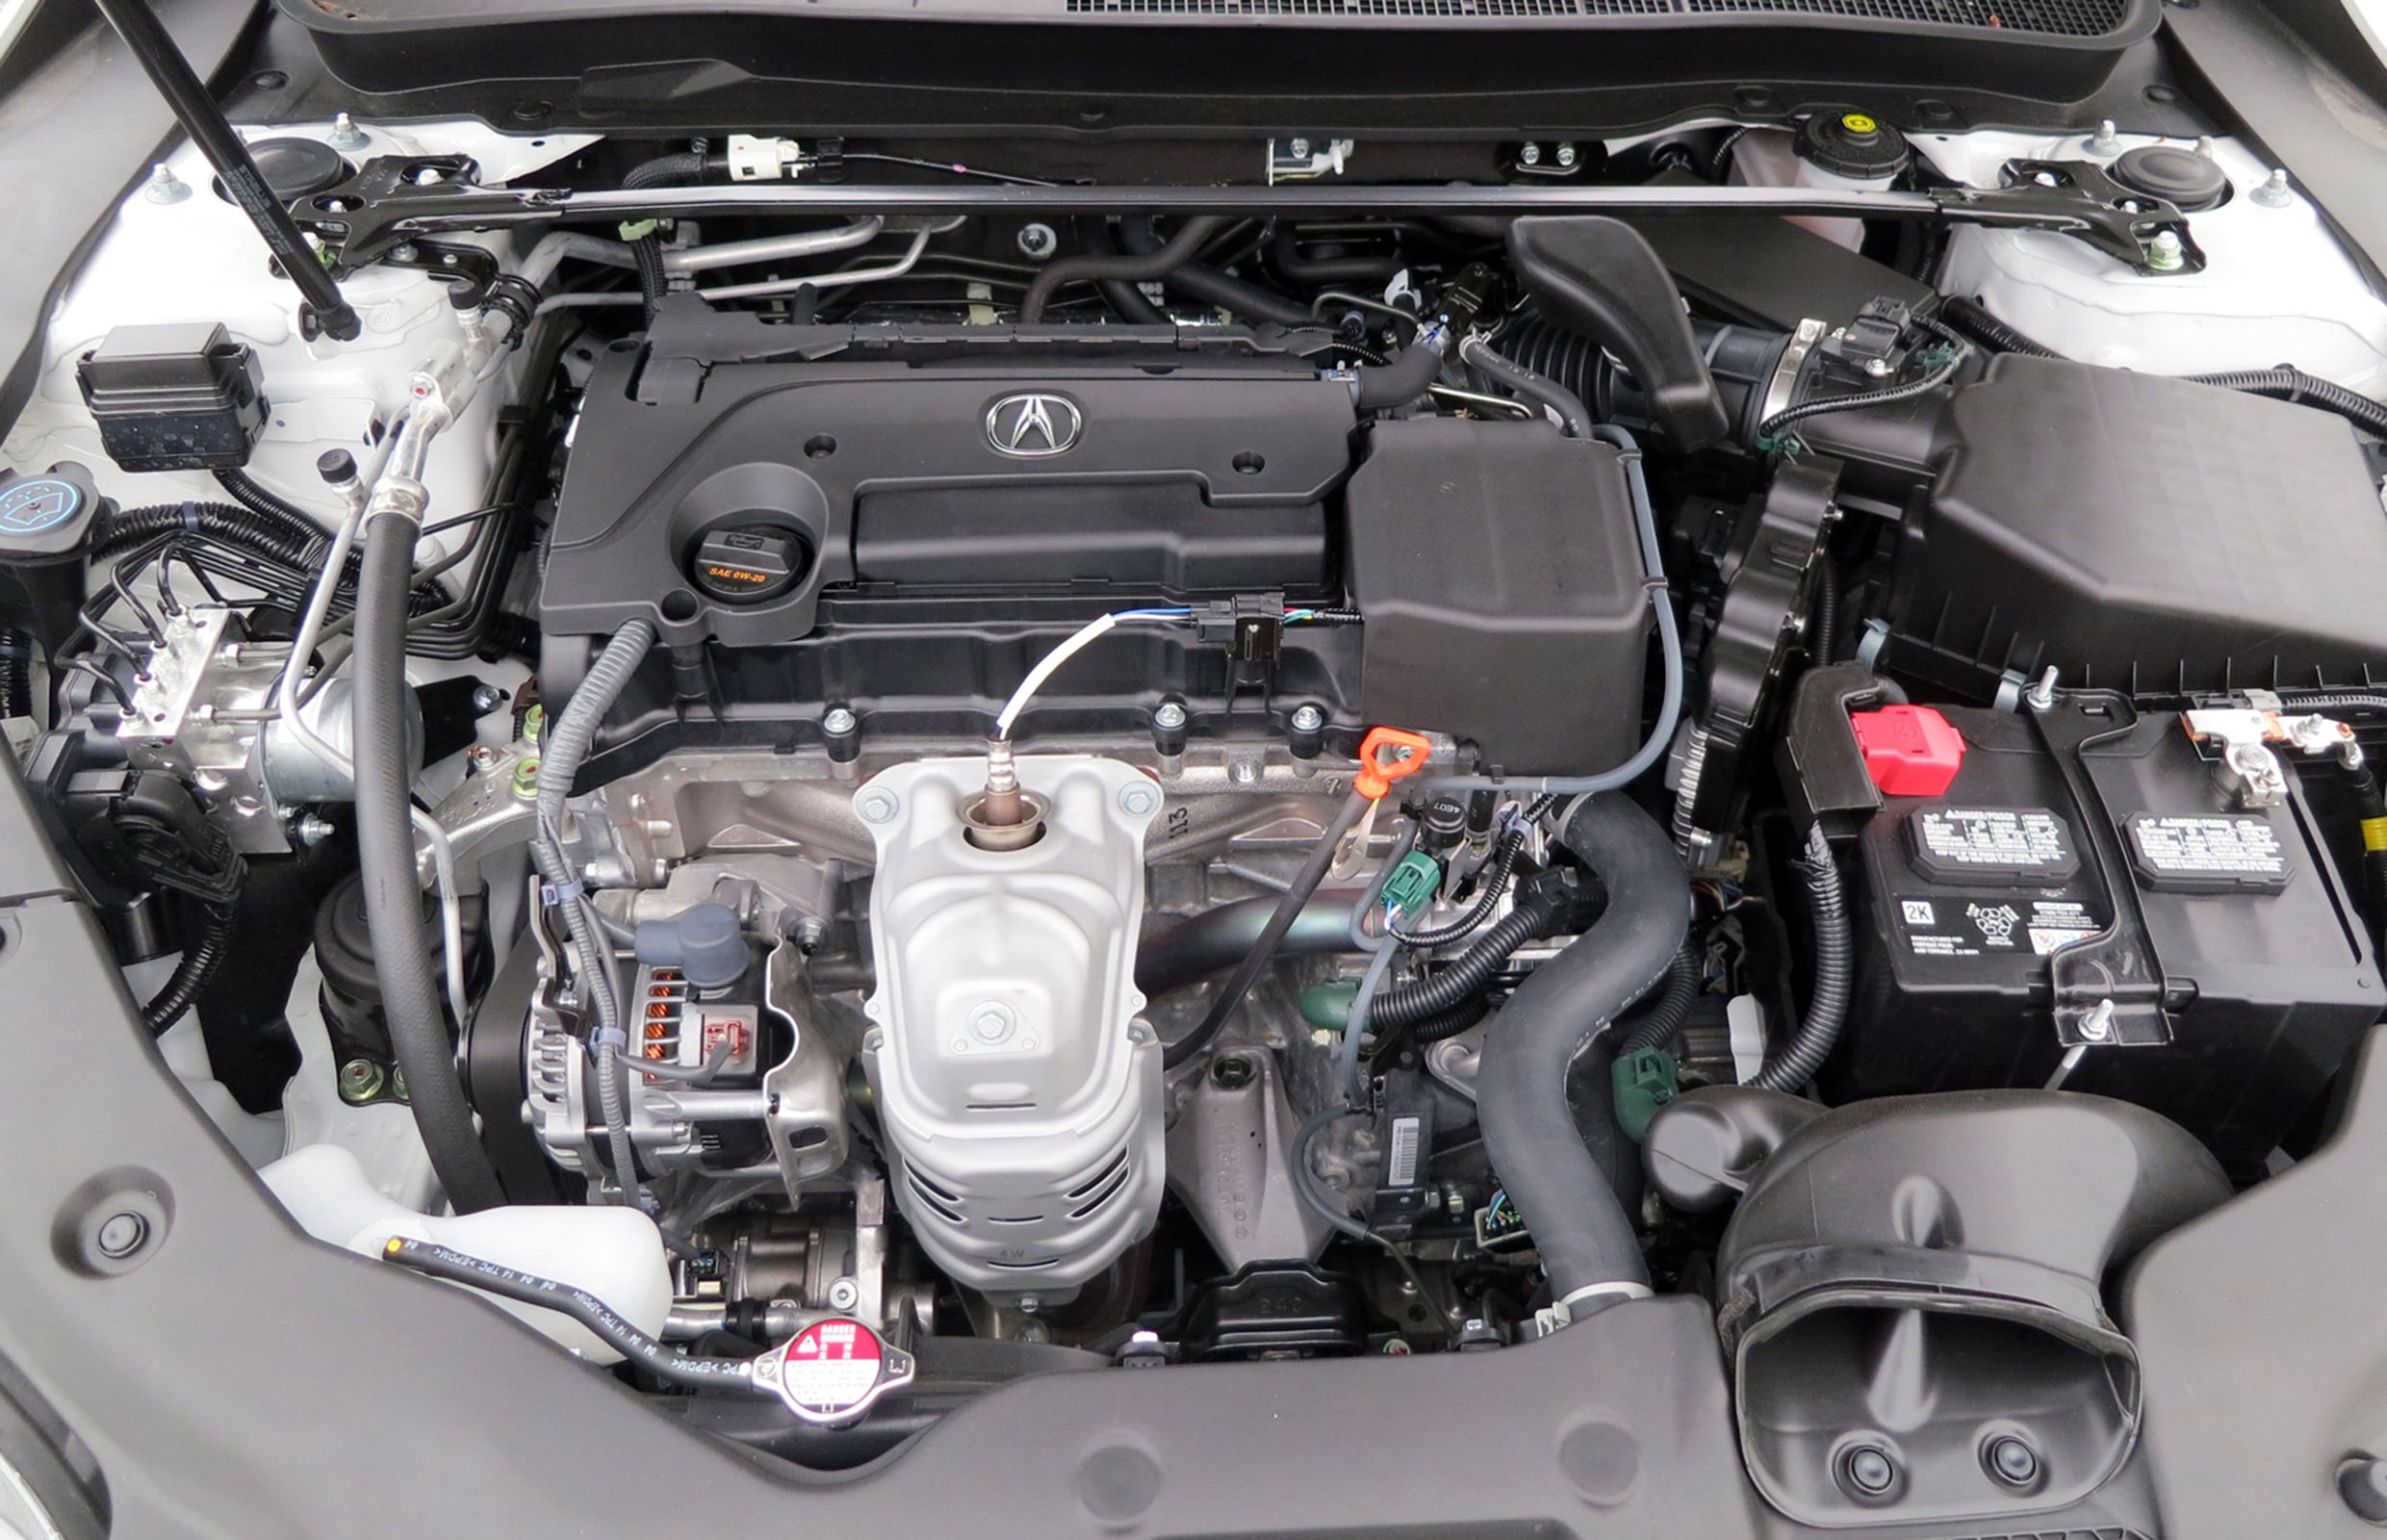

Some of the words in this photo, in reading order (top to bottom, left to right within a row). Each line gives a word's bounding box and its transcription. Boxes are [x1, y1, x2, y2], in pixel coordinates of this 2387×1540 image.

[709, 567, 732, 578] SAE
[732, 571, 766, 583] 0W-20
[1907, 905, 1931, 920] 2K
[478, 1262, 500, 1275] TPC
